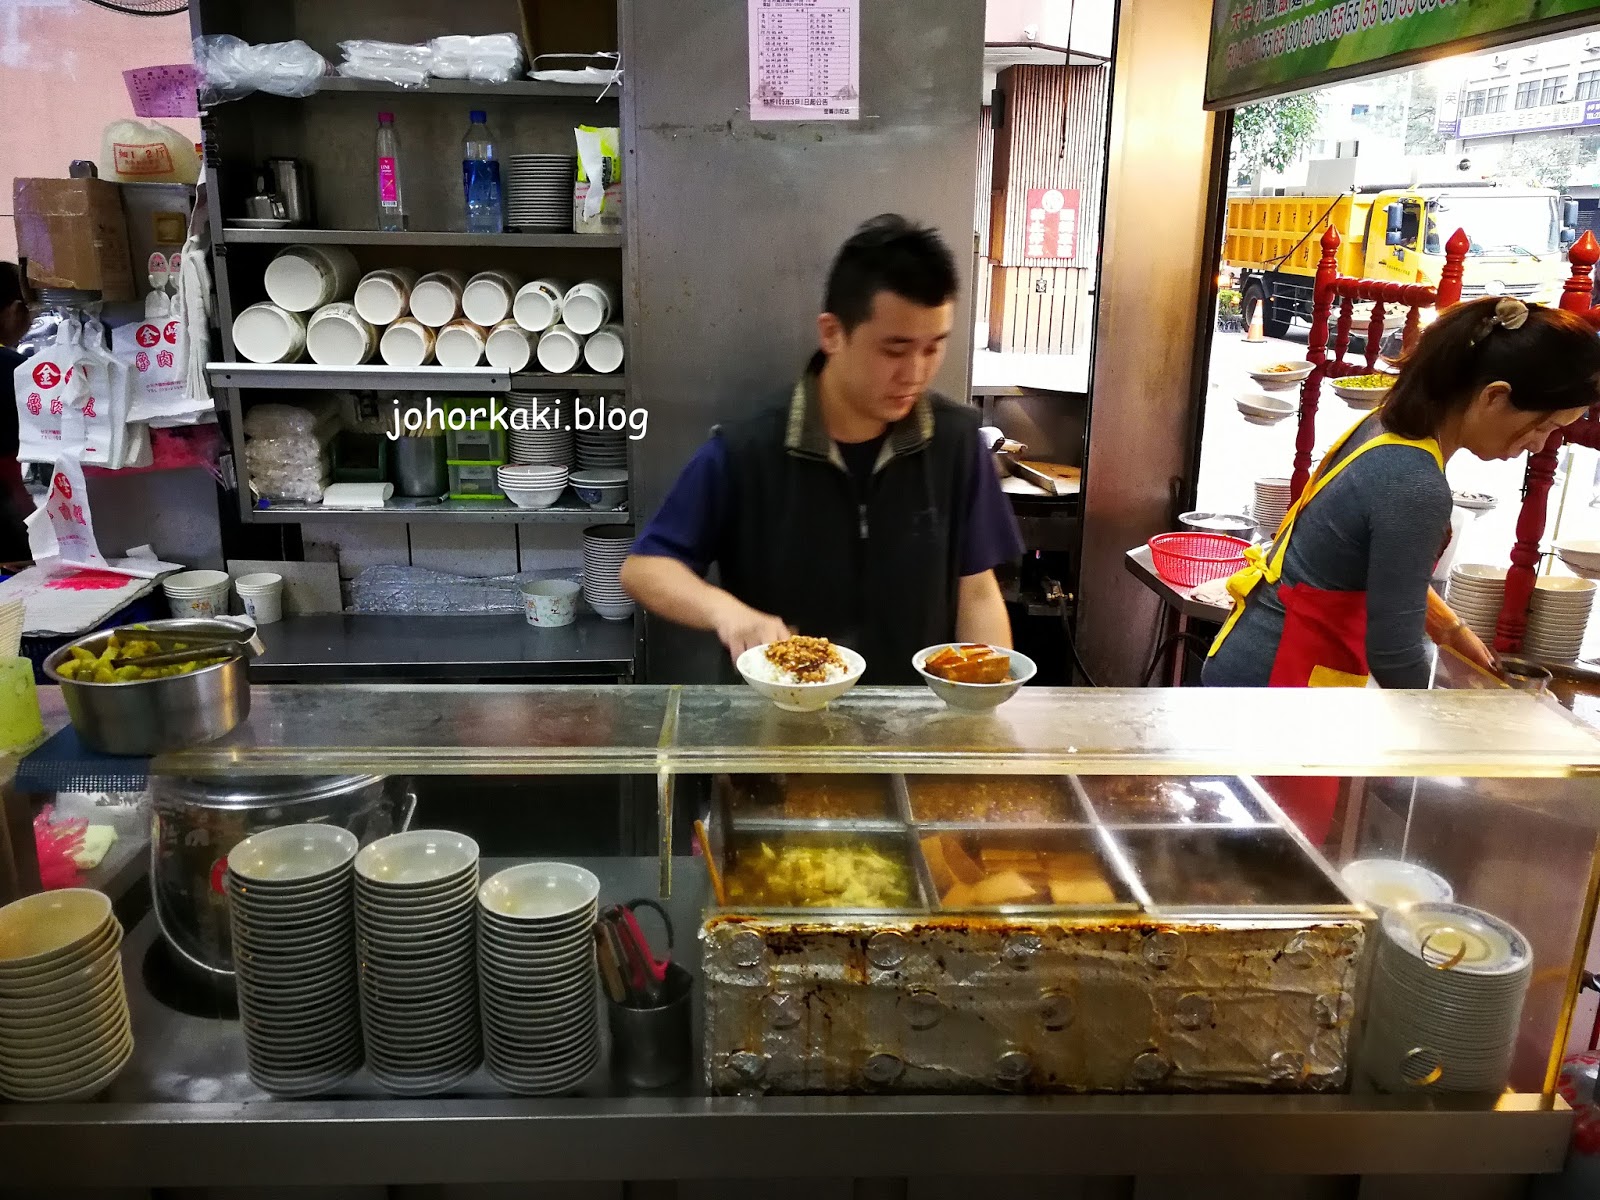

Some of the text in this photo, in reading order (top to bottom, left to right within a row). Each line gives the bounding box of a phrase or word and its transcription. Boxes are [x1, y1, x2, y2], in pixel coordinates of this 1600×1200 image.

[1287, 21, 1300, 51] 30
[1301, 16, 1315, 46] 30
[1315, 11, 1329, 41] 30
[1330, 6, 1345, 37] 55
[1346, 0, 1361, 31] 55
[1362, 0, 1378, 27] 55
